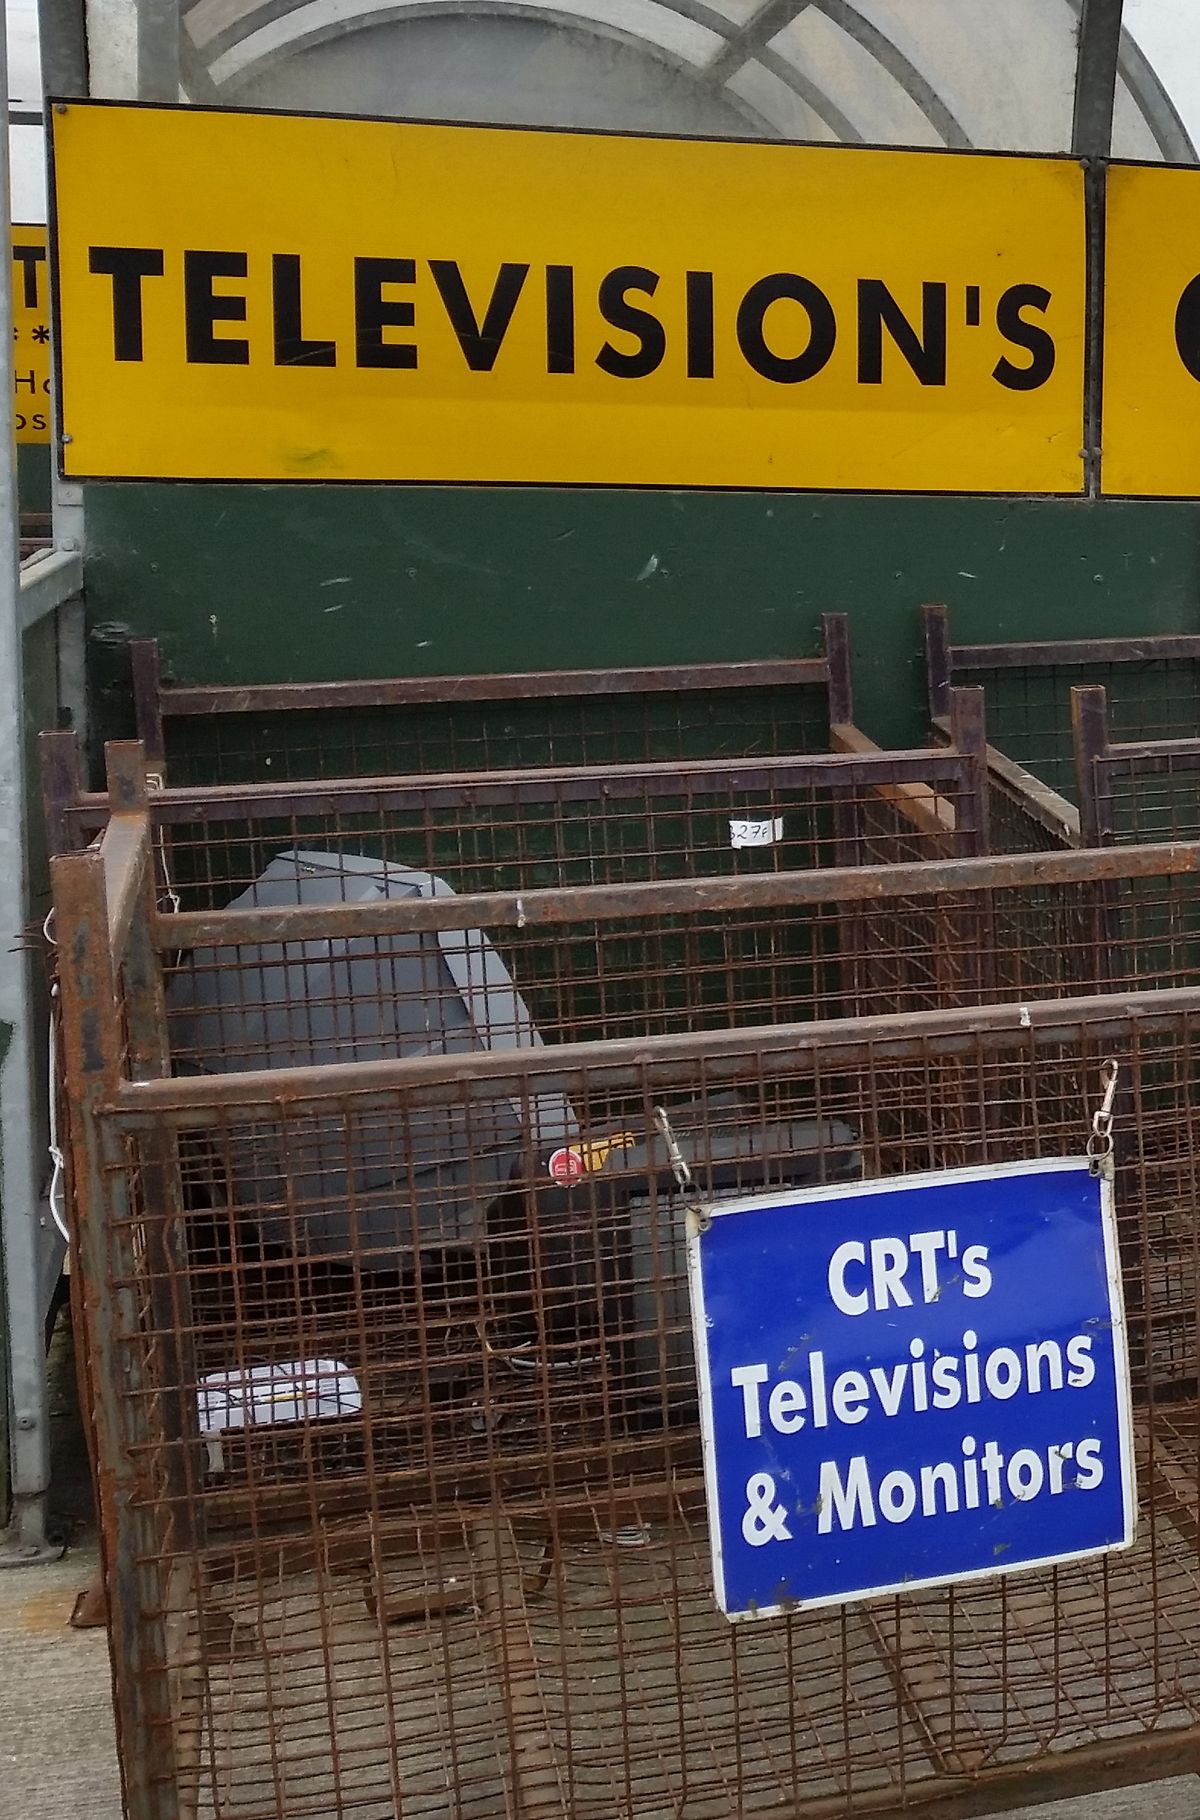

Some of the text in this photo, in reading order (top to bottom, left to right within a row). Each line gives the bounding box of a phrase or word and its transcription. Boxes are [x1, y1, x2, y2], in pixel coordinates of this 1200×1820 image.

[88, 246, 1056, 391] TELEVISION'S
[828, 1230, 993, 1316] CRT's
[731, 1330, 1096, 1438] Televisions
[742, 1435, 1104, 1546] & Monitors
